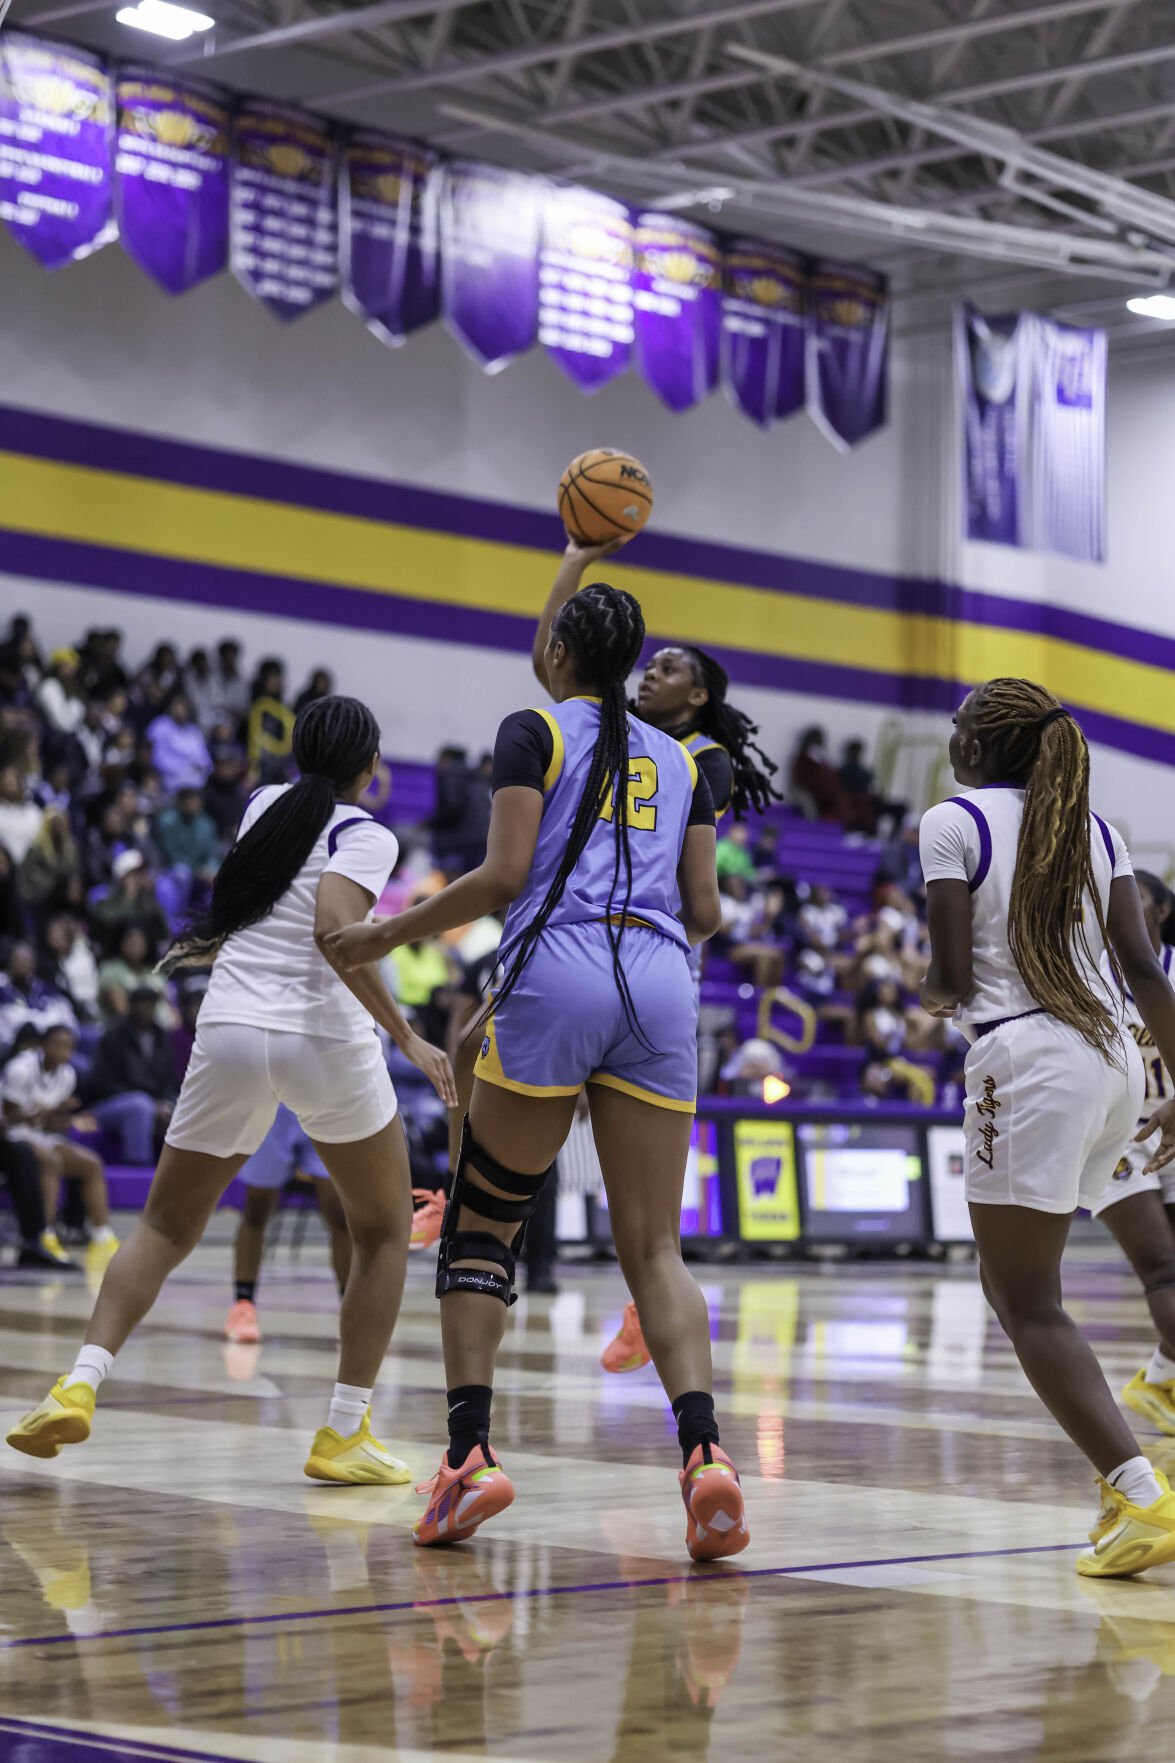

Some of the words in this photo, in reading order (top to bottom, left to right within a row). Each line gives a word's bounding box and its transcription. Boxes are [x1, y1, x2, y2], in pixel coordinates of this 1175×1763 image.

[976, 1075, 1001, 1119] Tigers
[977, 1121, 999, 1170] Lady
[458, 1276, 503, 1288] DONJOY
